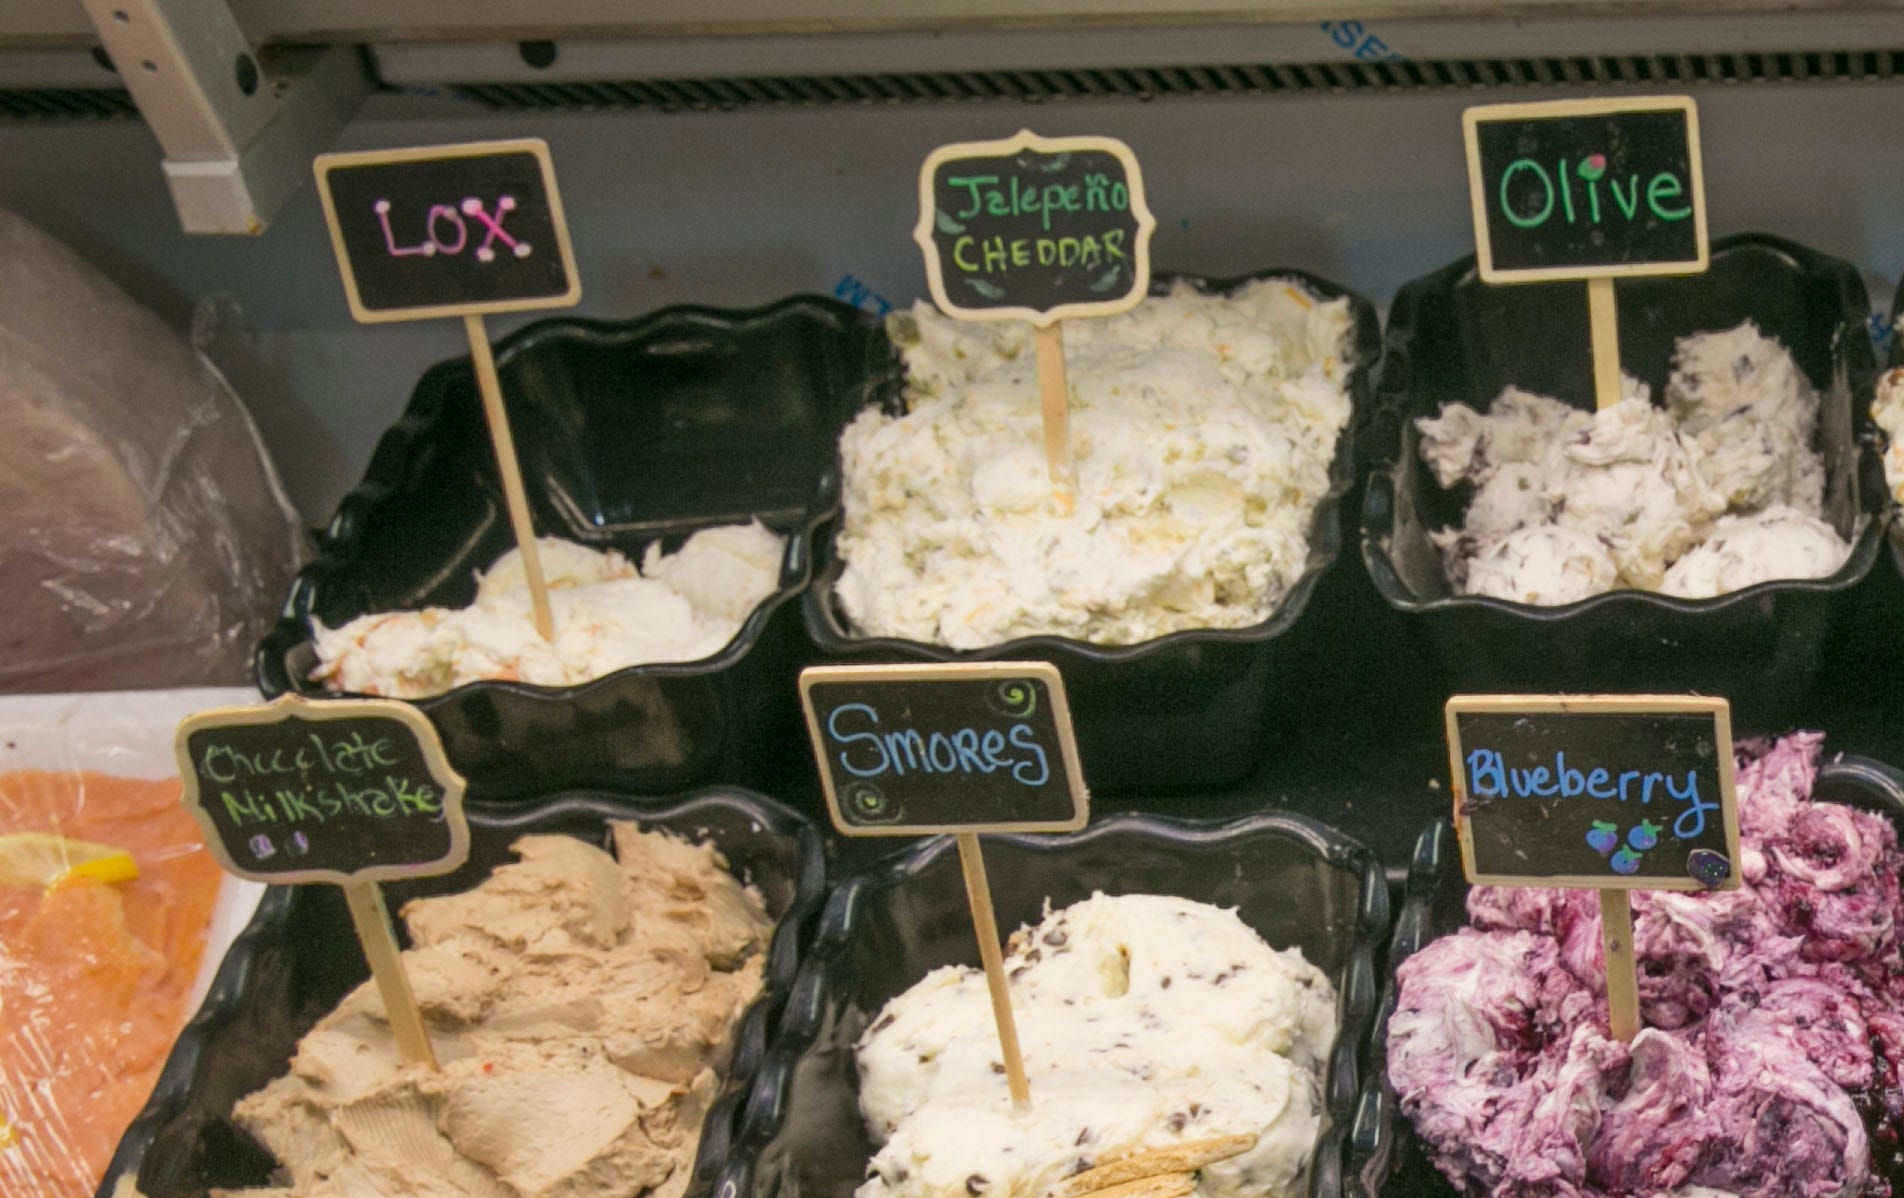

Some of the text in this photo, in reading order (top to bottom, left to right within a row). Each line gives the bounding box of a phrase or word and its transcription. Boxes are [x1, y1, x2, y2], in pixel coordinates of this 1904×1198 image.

[1500, 153, 1693, 229] Olive
[374, 196, 532, 263] LOX
[953, 229, 1126, 273] CHEDDAR
[220, 775, 445, 826] Milkshake
[1466, 748, 1721, 839] Blueberry
